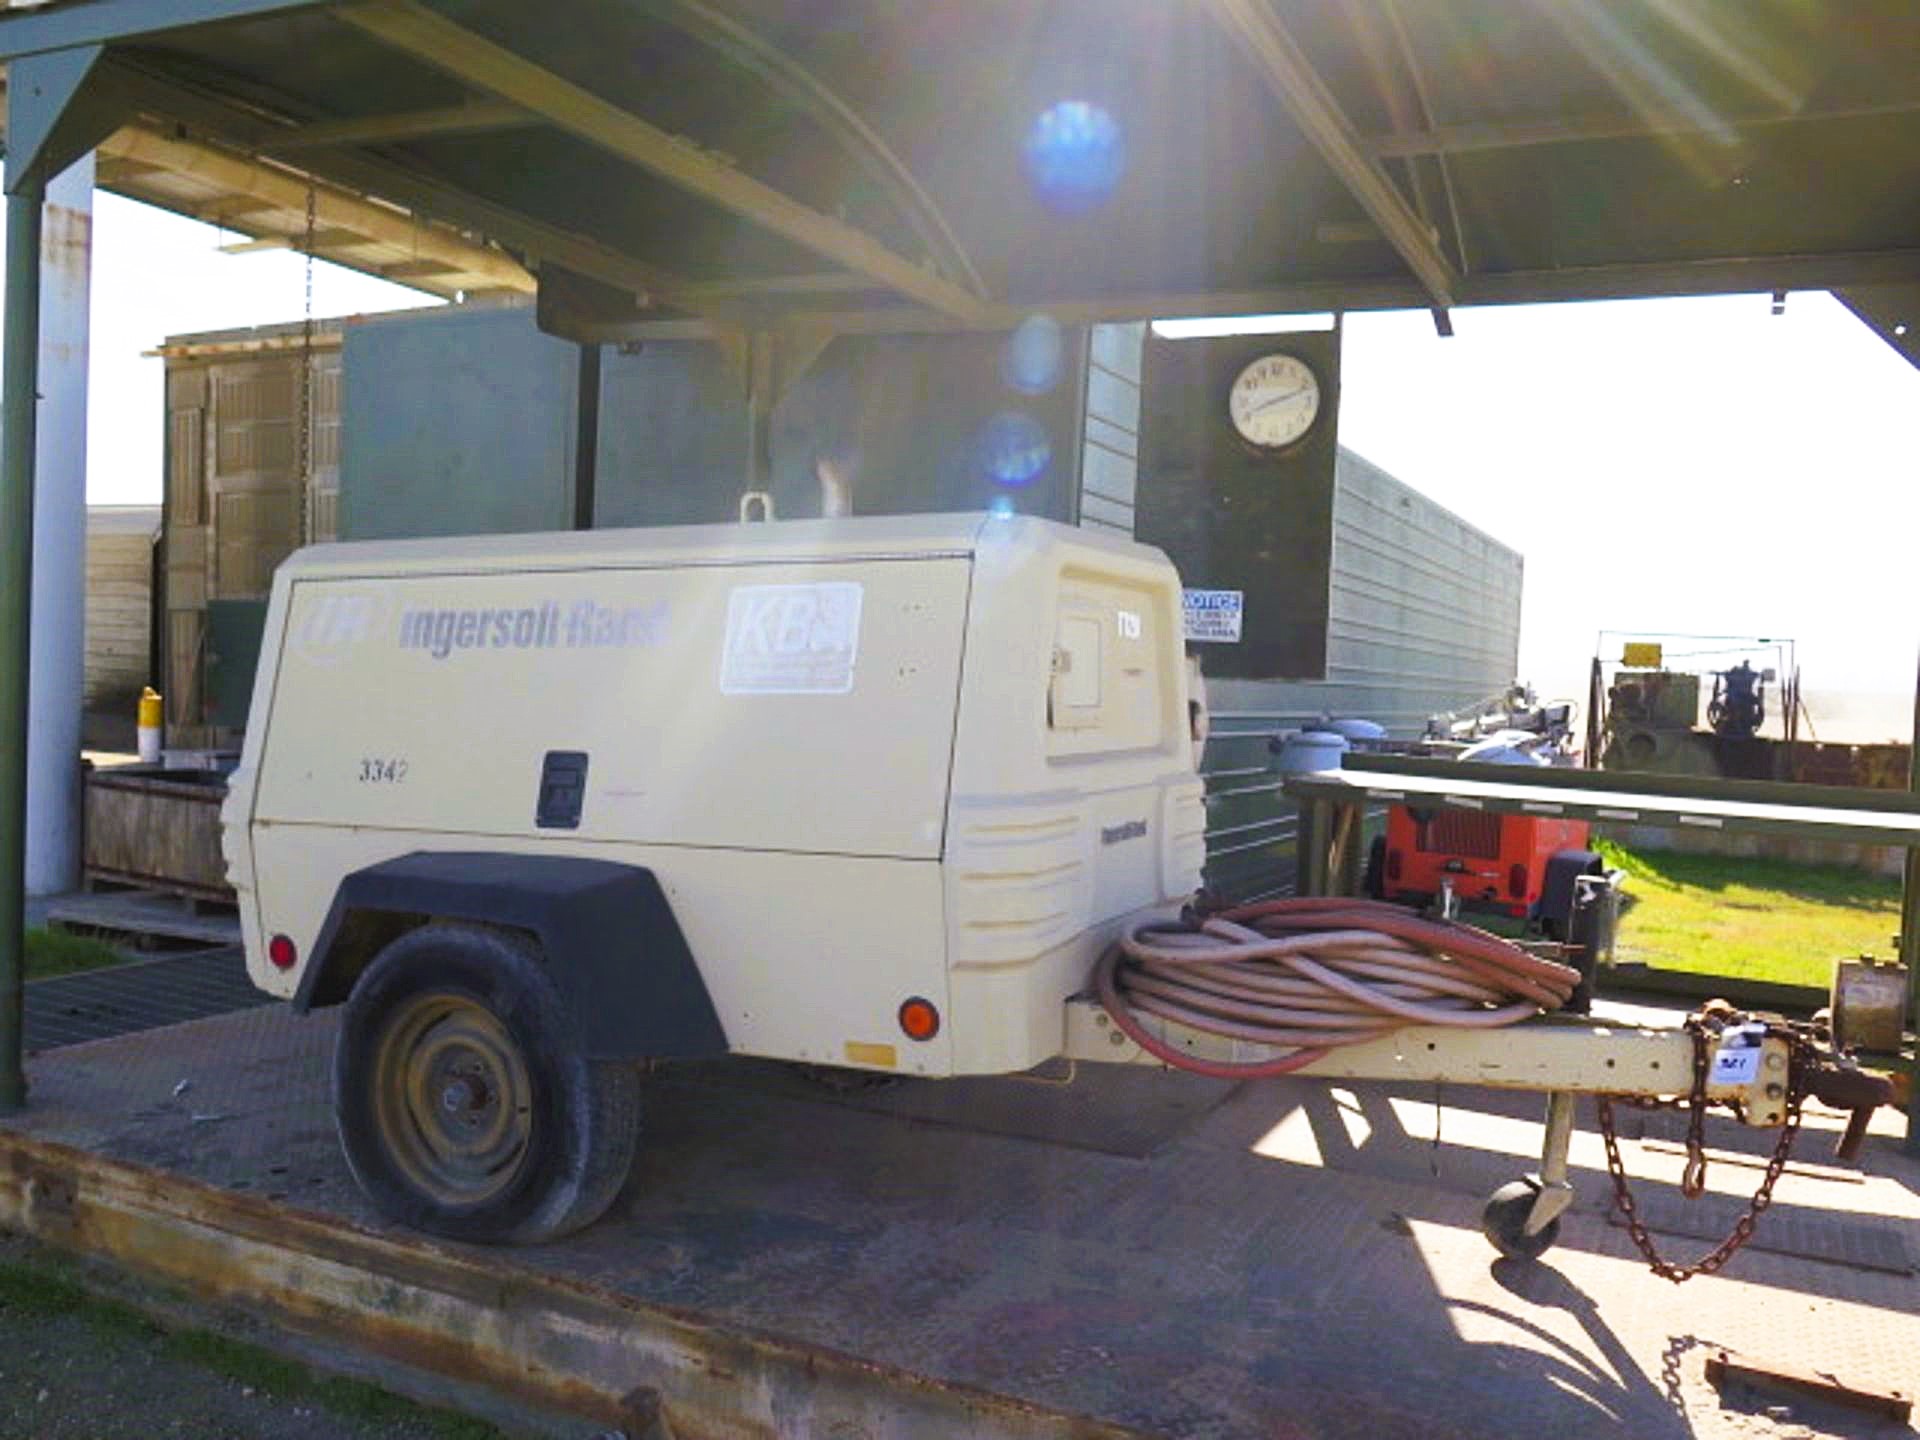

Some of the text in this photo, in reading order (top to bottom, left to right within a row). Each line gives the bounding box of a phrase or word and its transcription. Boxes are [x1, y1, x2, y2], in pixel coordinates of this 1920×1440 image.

[1182, 593, 1240, 609] NOTICE
[400, 601, 559, 659] Ingersoll
[359, 757, 408, 784] 3342
